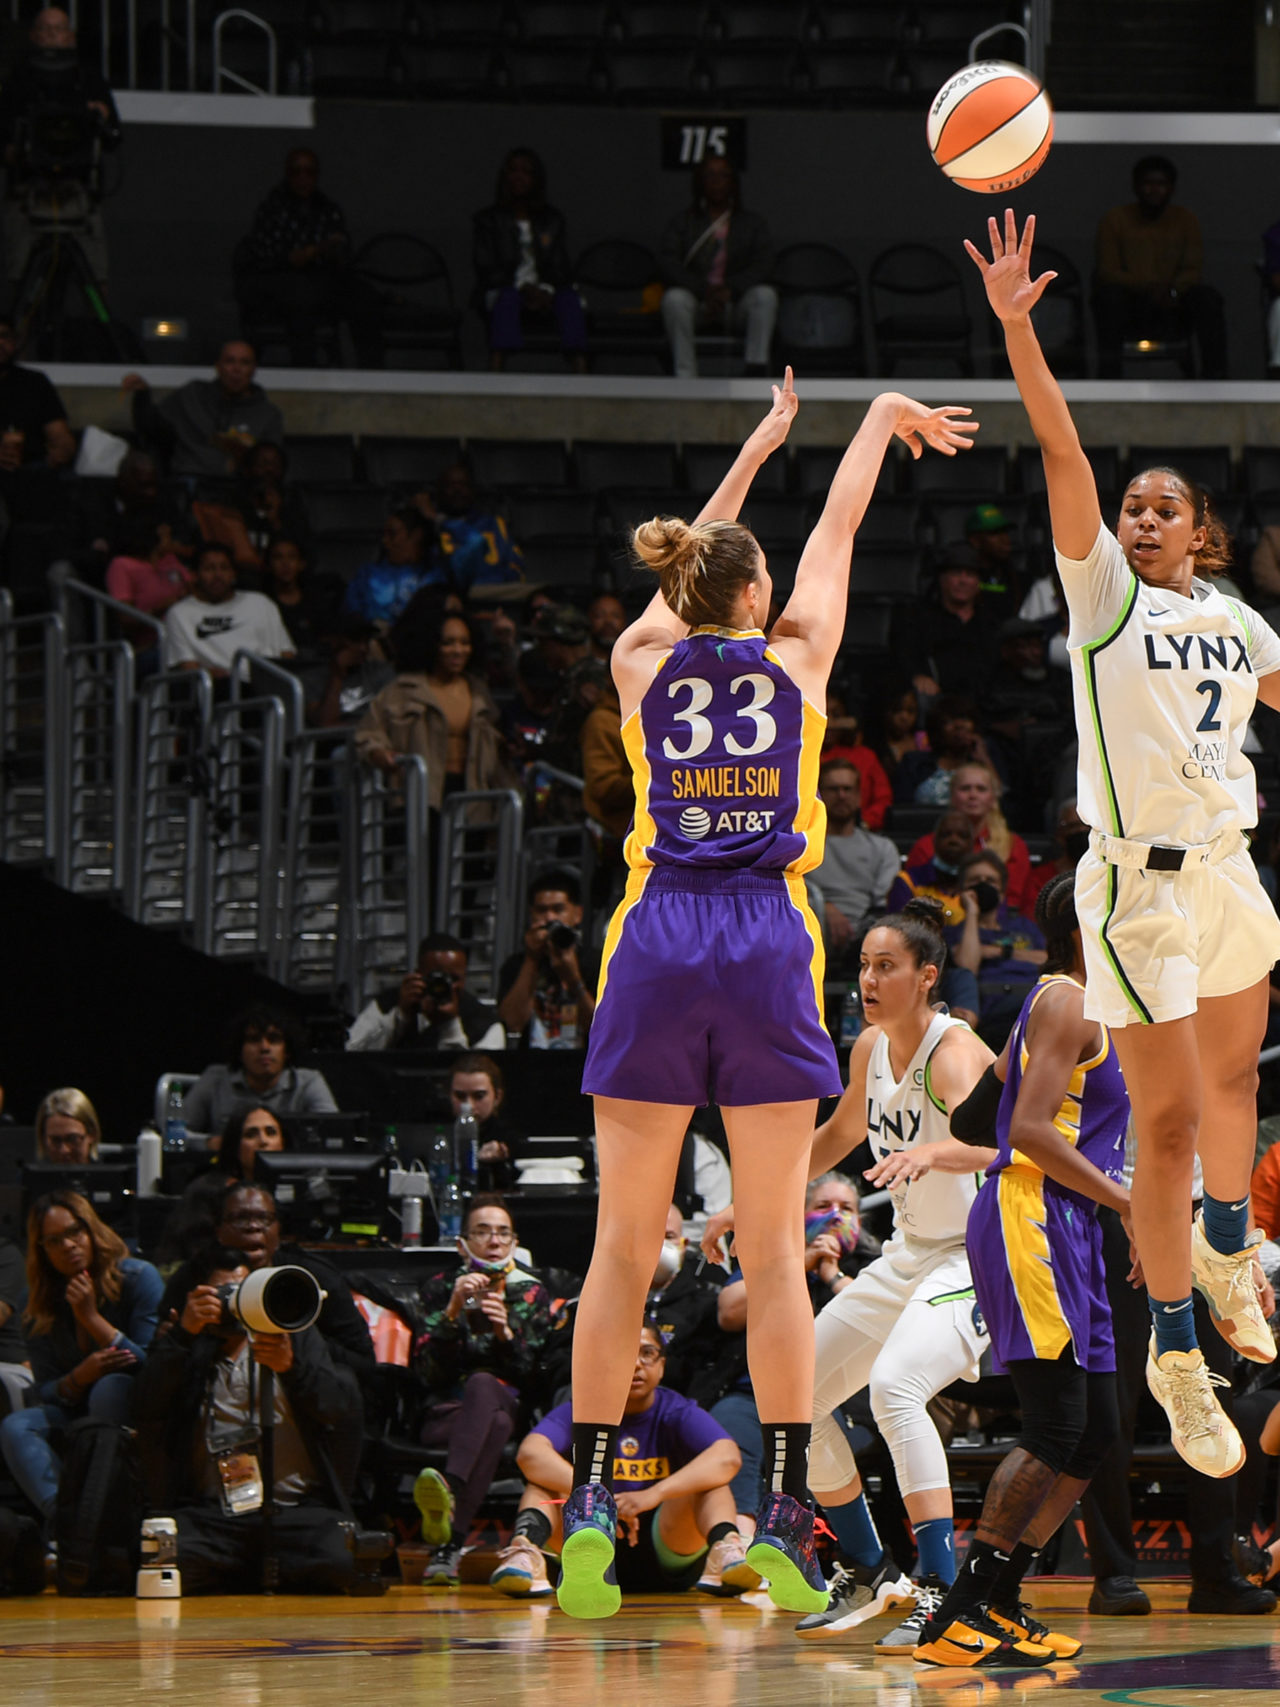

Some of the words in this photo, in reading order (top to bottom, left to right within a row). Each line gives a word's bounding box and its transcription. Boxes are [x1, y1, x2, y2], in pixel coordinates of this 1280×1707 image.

[680, 125, 728, 165] 115
[1144, 633, 1252, 674] LYNX
[662, 673, 777, 760] 33
[1196, 680, 1222, 732] 2
[671, 767, 780, 799] SAMUELSON
[715, 811, 775, 833] AT&T
[615, 1460, 664, 1477] ARKS
[1137, 1551, 1191, 1561] ELTZER
